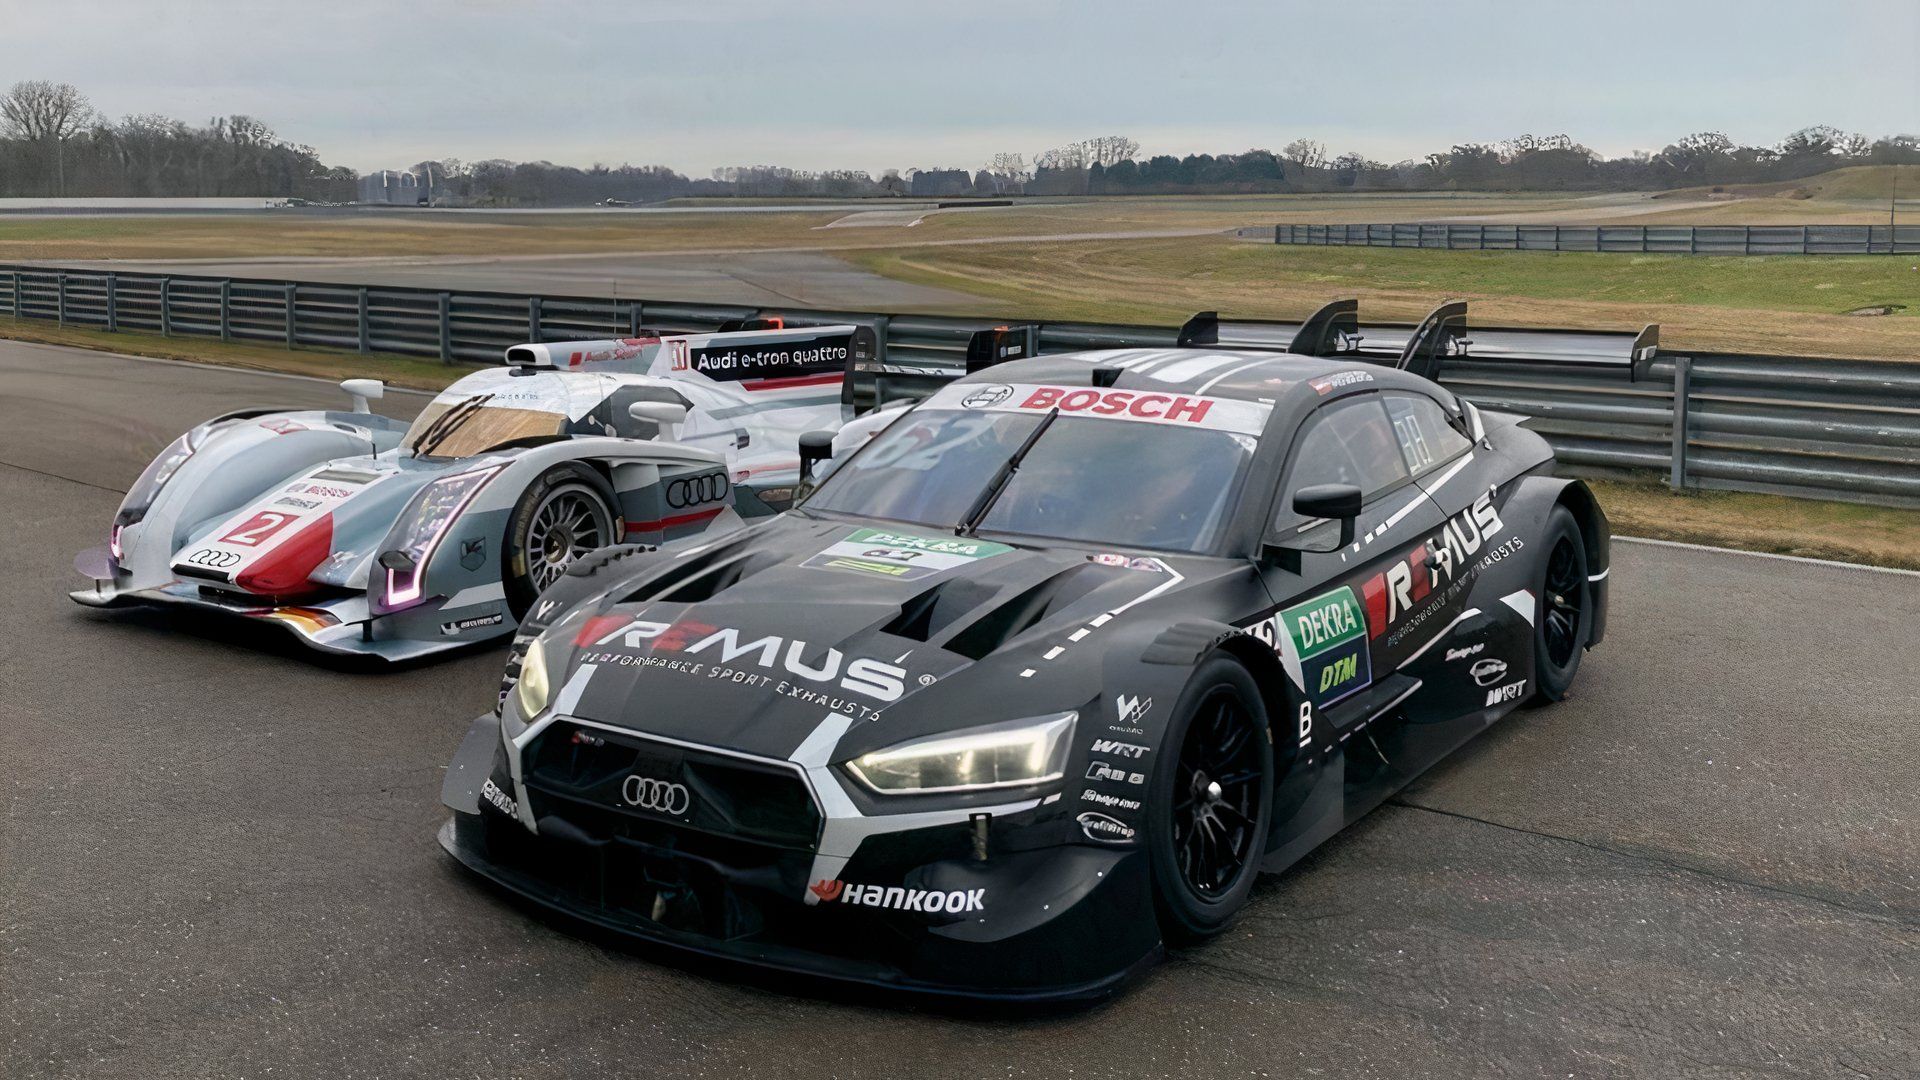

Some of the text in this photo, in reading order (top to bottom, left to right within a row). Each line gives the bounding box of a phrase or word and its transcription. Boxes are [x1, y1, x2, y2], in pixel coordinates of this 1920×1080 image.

[697, 347, 847, 370] Audi e-tron quattro
[1018, 387, 1215, 423] BOSCH
[225, 512, 284, 543] 2
[1298, 599, 1358, 650] DEKRA
[708, 666, 772, 687] SPORT
[1319, 653, 1358, 693] DTM
